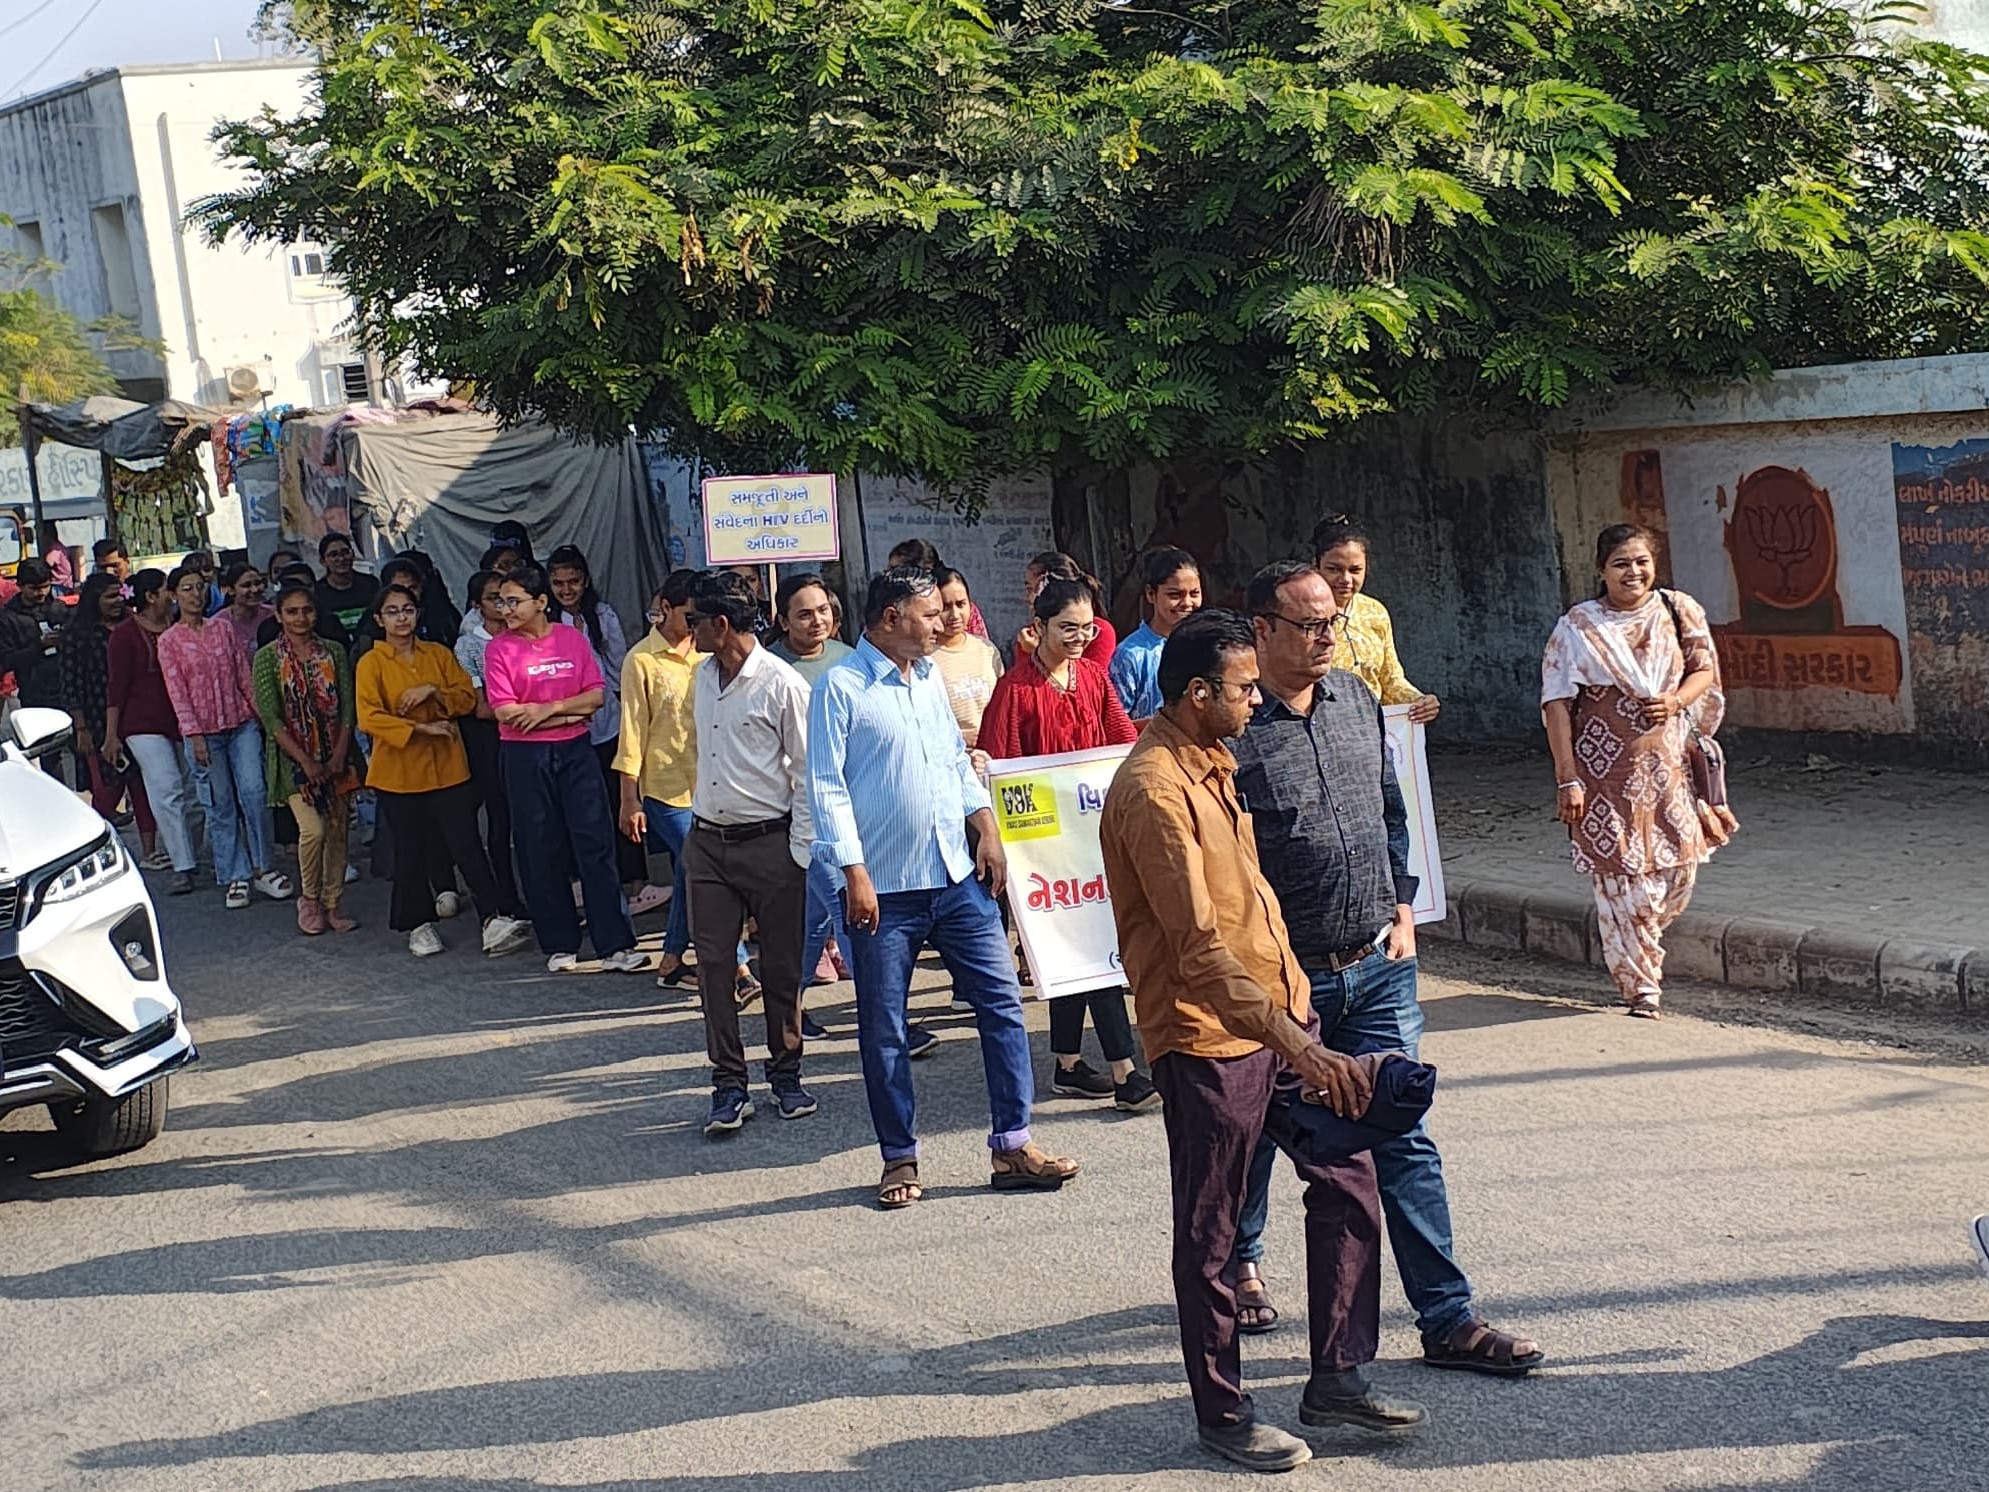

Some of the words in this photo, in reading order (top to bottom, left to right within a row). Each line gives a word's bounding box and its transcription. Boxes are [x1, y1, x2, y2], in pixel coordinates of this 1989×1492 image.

[783, 486, 809, 502] અને
[714, 514, 758, 530] સંવેદના
[763, 515, 789, 526] HIV
[746, 535, 800, 551] અધિકાર
[1783, 652, 1874, 684] સરકાર
[1078, 782, 1107, 811] વિ
[1027, 872, 1108, 910] નેશન
